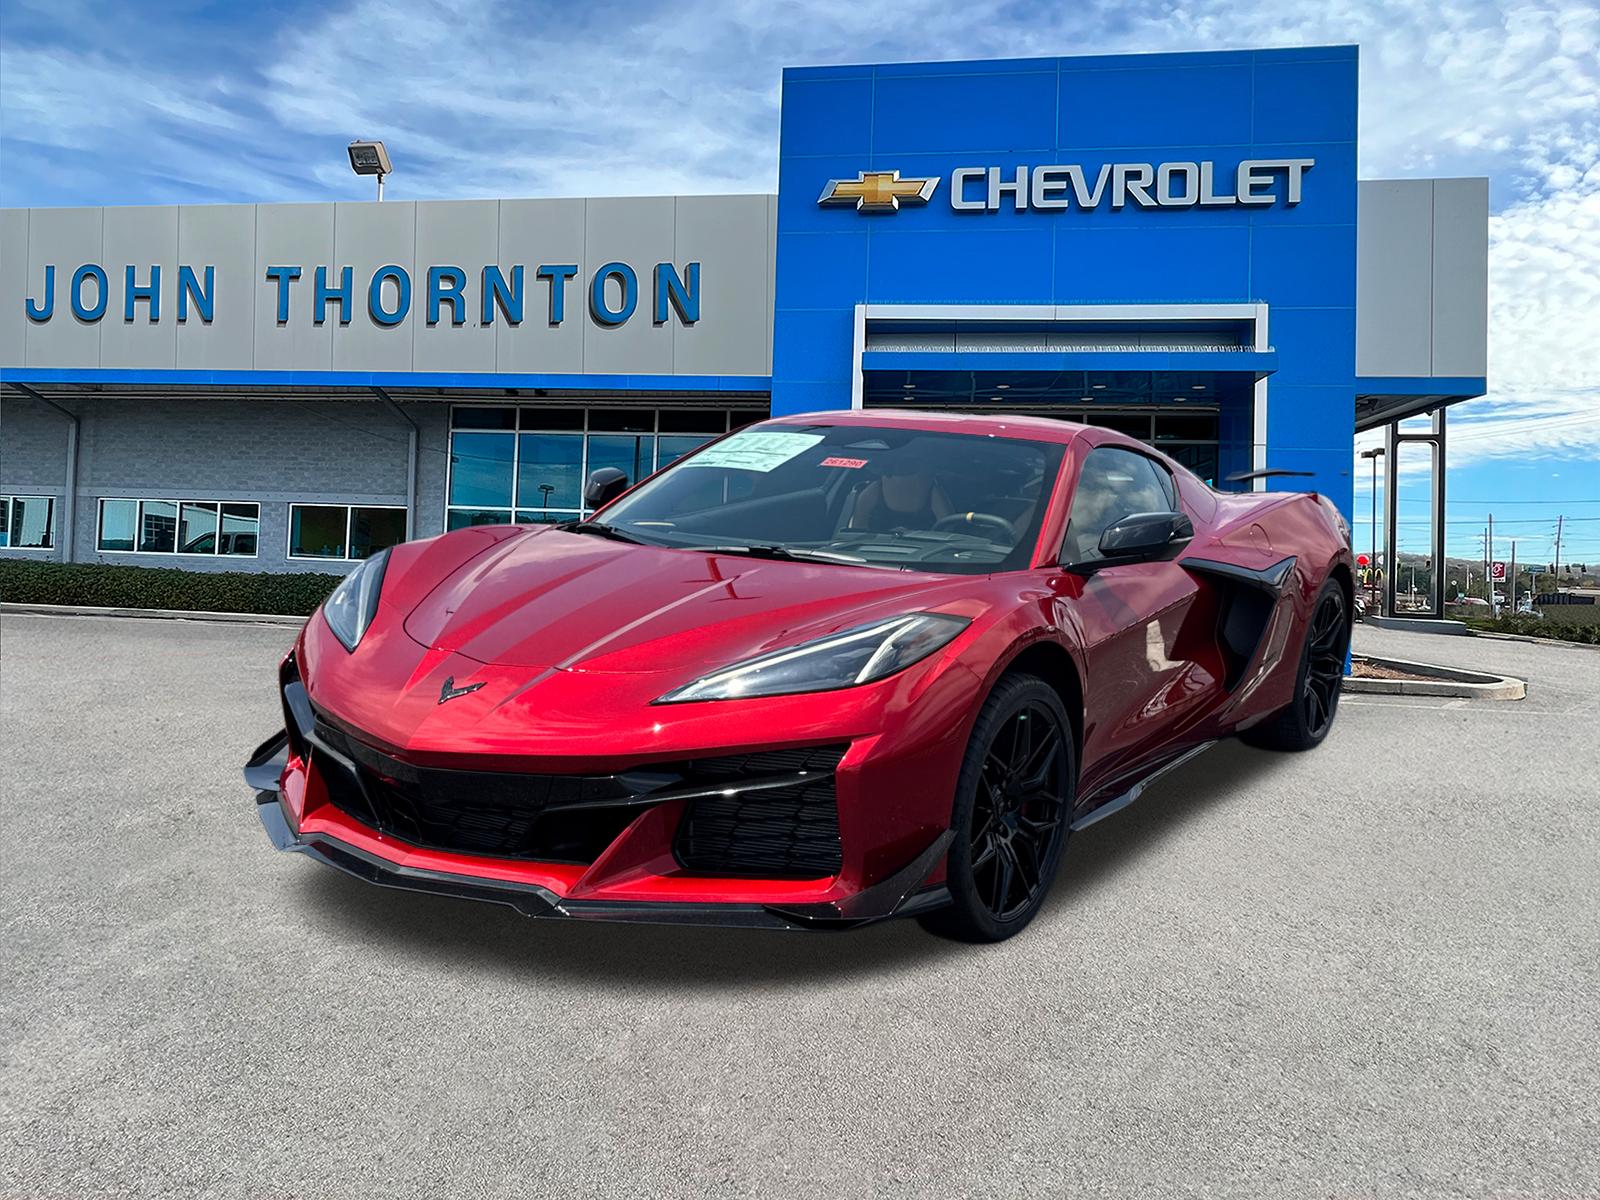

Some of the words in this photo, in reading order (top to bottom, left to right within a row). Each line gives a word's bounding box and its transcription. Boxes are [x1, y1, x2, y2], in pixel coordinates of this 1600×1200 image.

[951, 158, 1316, 211] CHEVROLET
[25, 263, 215, 323] JOHN
[266, 262, 701, 328] THORNTON
